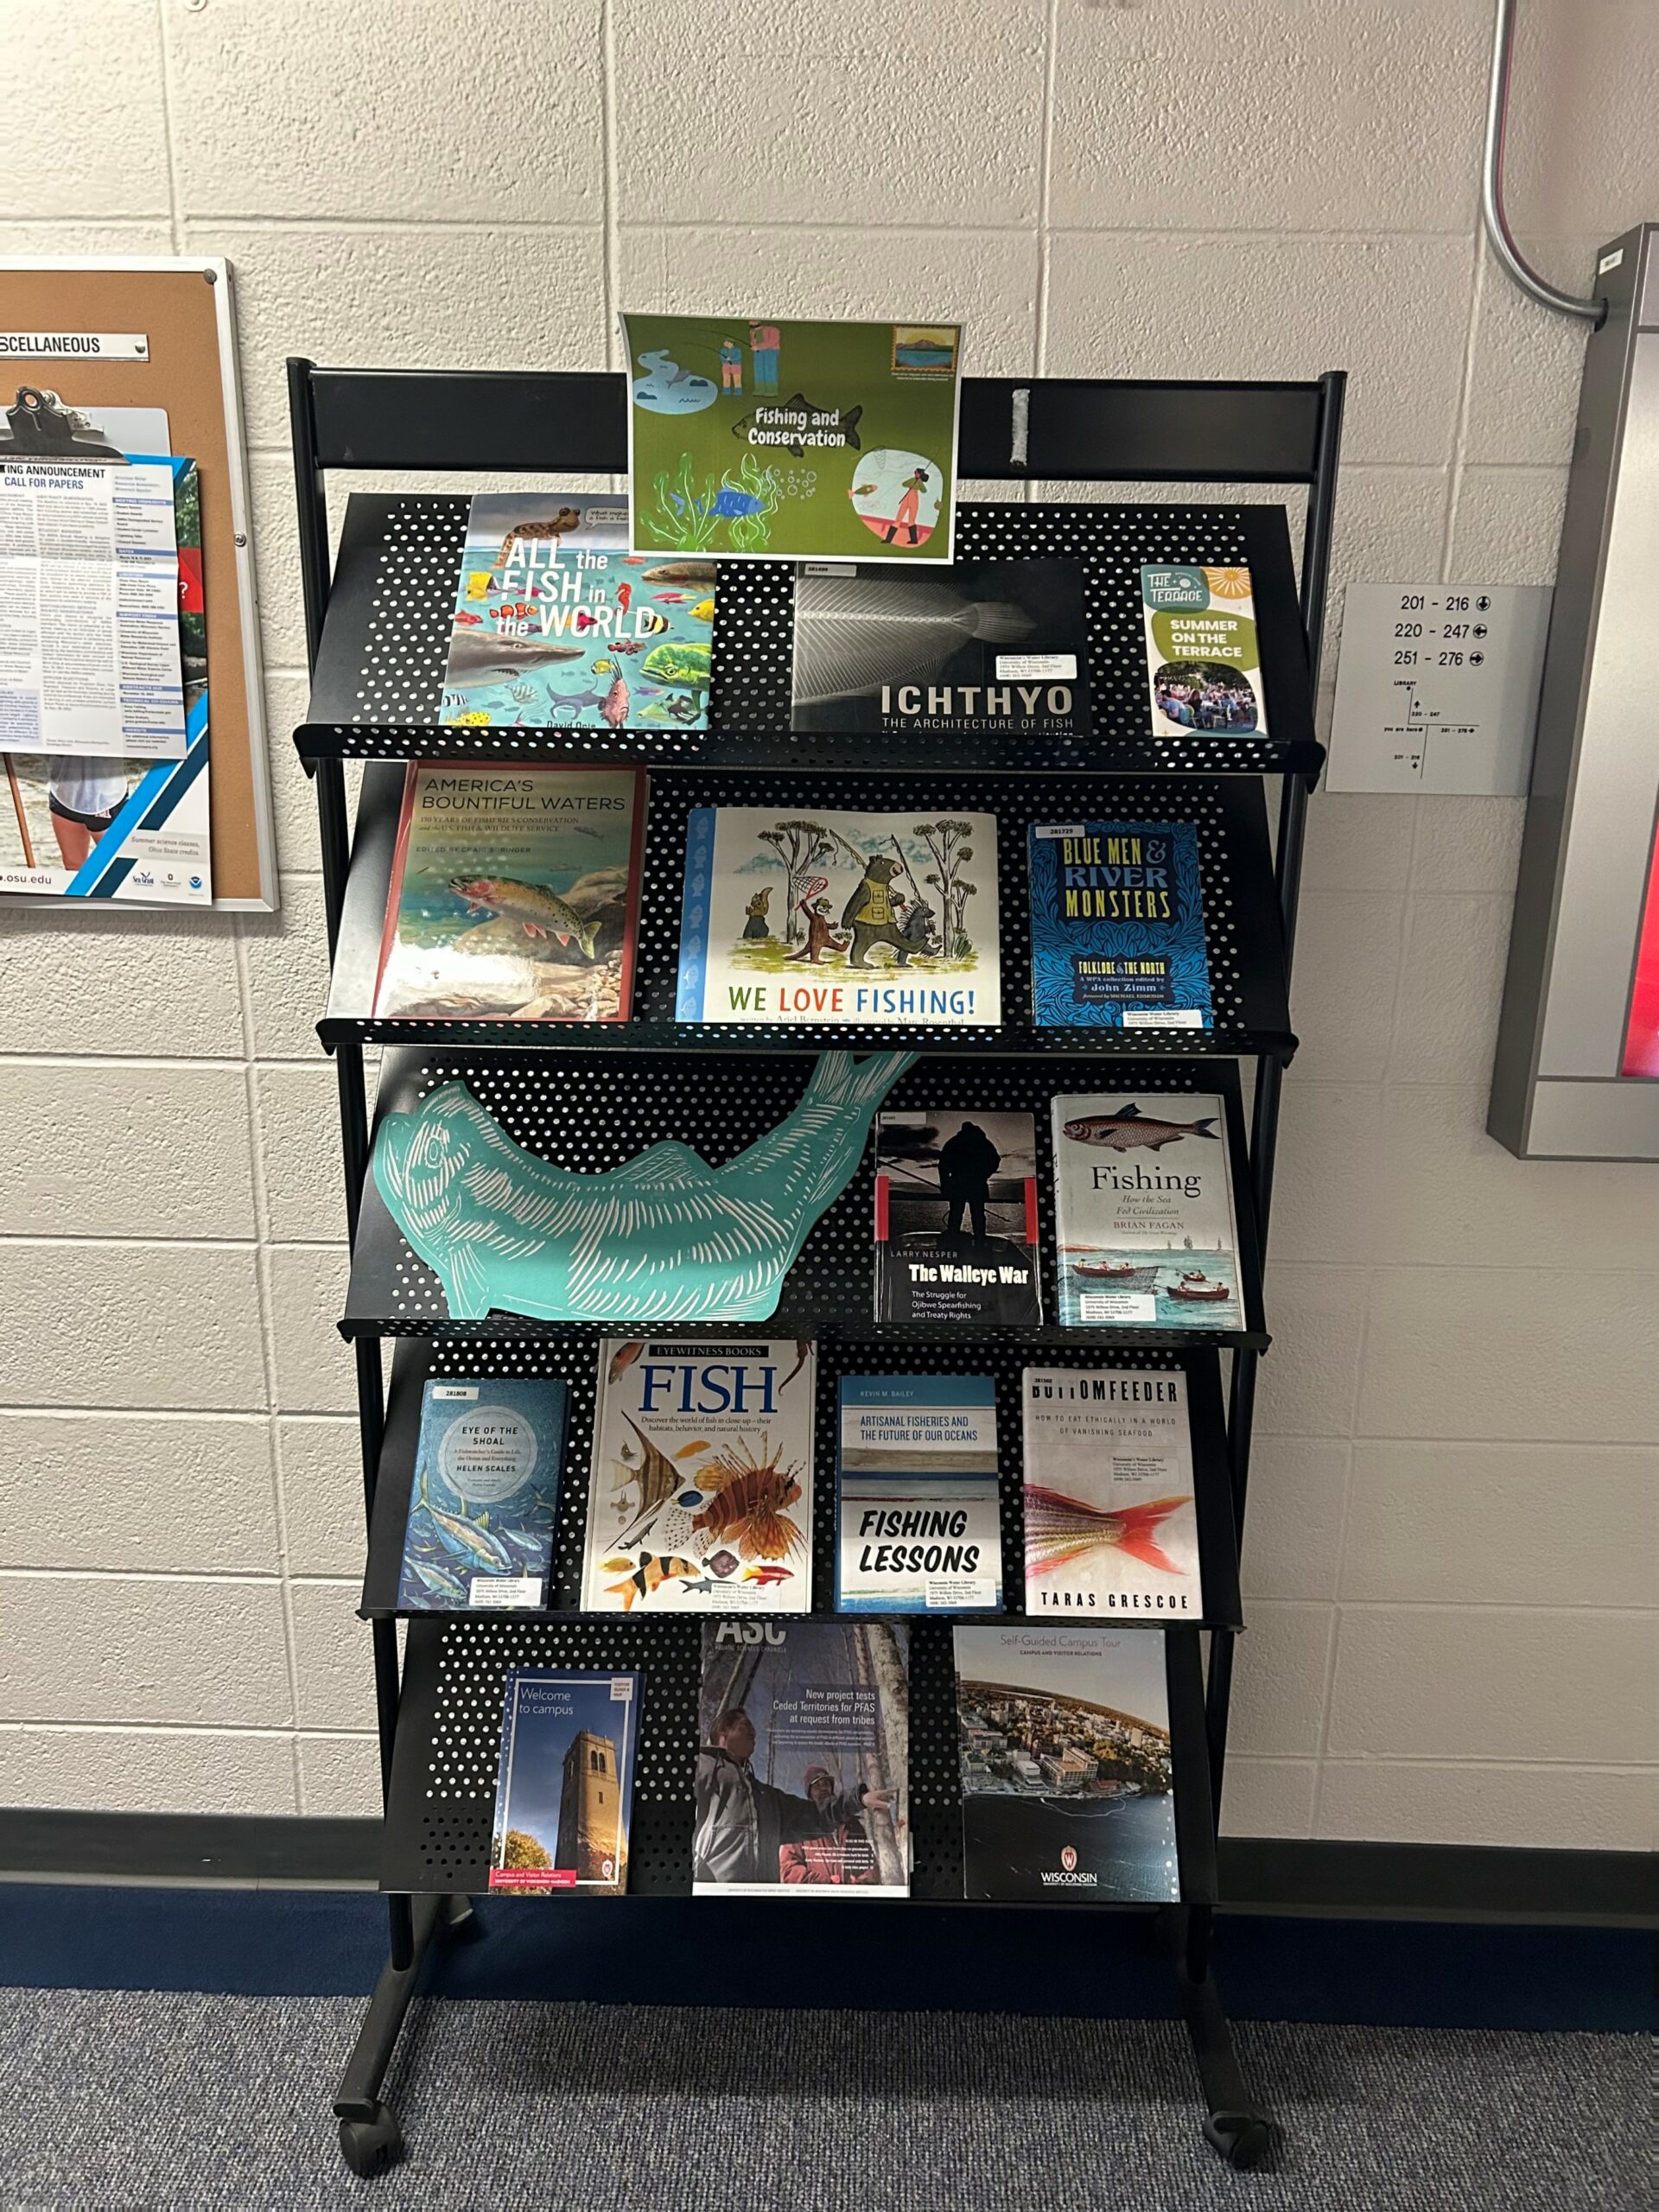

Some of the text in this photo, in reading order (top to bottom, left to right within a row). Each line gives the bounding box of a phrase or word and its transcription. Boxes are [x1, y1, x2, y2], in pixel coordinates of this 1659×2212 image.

[756, 407, 839, 430] Fishing and
[748, 428, 845, 446] Conservation
[26, 466, 105, 478] ANNOUNCEMENT
[5, 477, 83, 489] CALL FOR PAPERS
[505, 537, 607, 569] ALL the
[501, 570, 605, 603] FISH in
[1147, 573, 1171, 588] THE
[180, 582, 188, 599] ?
[1150, 588, 1202, 602] TERRACE
[1401, 595, 1424, 610] 201
[1446, 597, 1469, 611] 216
[496, 605, 656, 639] the WORLD
[1170, 620, 1237, 630] SUMMER
[1172, 633, 1227, 644] ON THE
[1395, 624, 1422, 637] 220
[1444, 625, 1469, 639] 247
[1173, 646, 1243, 657] TERRACE
[1395, 651, 1417, 664] 251
[1439, 652, 1463, 665] 276
[881, 686, 1072, 715] ICHTHYO
[883, 718, 1073, 728] THE ARCHITECTURE OF FISH
[425, 779, 533, 791] AMERICA'S
[423, 797, 626, 810] BOUNTIFUL WATERS
[1063, 838, 1166, 865] BLUE MEN &
[1065, 867, 1168, 887] RIVER
[1066, 890, 1171, 918] MONSTERS
[1079, 962, 1116, 974] FOLKLORE
[1124, 963, 1138, 974] THE
[1141, 963, 1165, 974] NORTH
[728, 986, 975, 1014] WE LOVE FISHING!
[1091, 1165, 1201, 1198] Fishing
[909, 1264, 1028, 1286] The Walleye War
[926, 1292, 955, 1300] Struggle
[726, 1347, 761, 1356] BOOKS
[639, 1365, 778, 1414] FISH
[861, 1416, 969, 1427] ARTISANAL FISHERIES AND
[861, 1430, 977, 1440] THE FUTURE OF OUR OCEANS
[859, 1510, 967, 1537] FISHING
[859, 1545, 979, 1573] LESSONS
[1041, 1592, 1187, 1609] TARAS GRESCOE
[715, 1622, 785, 1645] ASC
[1001, 1635, 1121, 1649] Self-Guided Campus Tour
[521, 1688, 571, 1700] Welcome
[806, 1689, 823, 1698] New
[827, 1691, 853, 1700] project
[519, 1705, 573, 1717] to campus
[773, 1700, 875, 1713] Ceded Territories for PFAS
[800, 1716, 830, 1725] request
[832, 1714, 849, 1724] from
[853, 1716, 875, 1725] tribes
[1041, 1872, 1097, 1883] WISCONSIN
